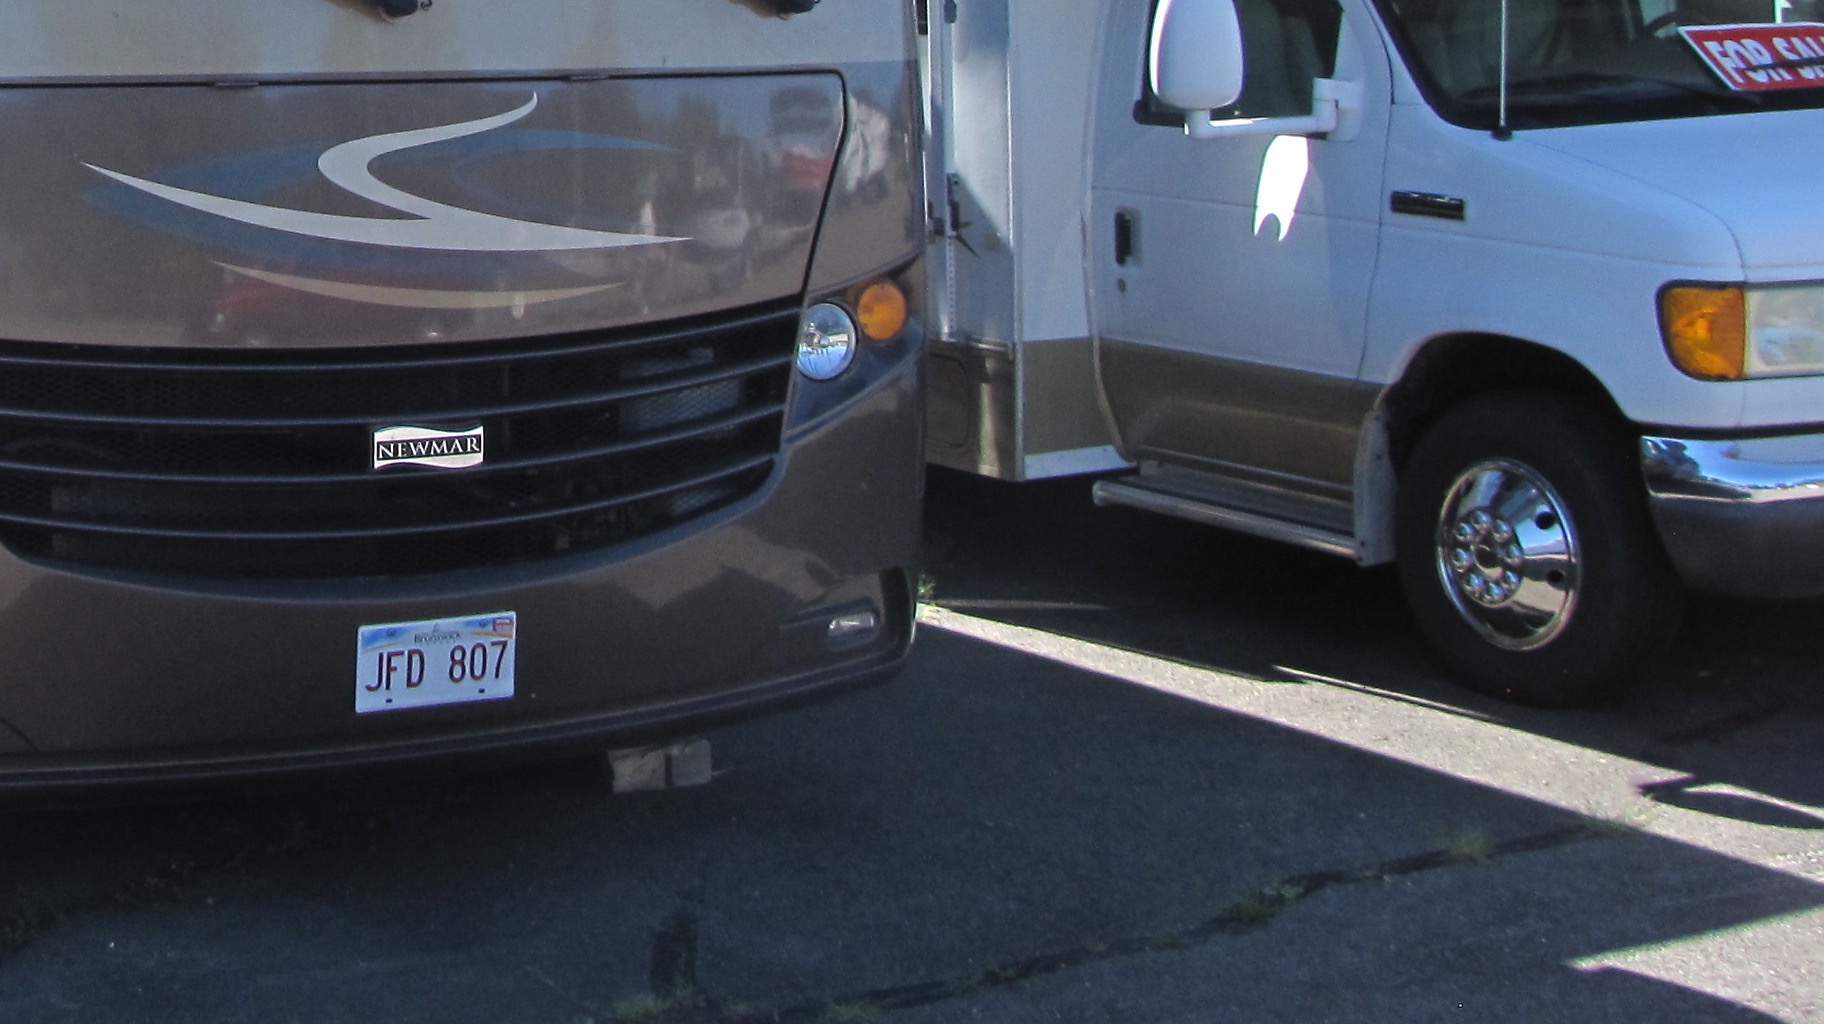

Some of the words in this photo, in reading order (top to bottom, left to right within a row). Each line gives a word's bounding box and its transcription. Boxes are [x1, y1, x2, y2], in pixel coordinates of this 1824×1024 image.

[1702, 37, 1794, 84] FOR
[377, 436, 481, 460] NEWMAR
[364, 648, 427, 693] JFD
[448, 639, 509, 684] 807
